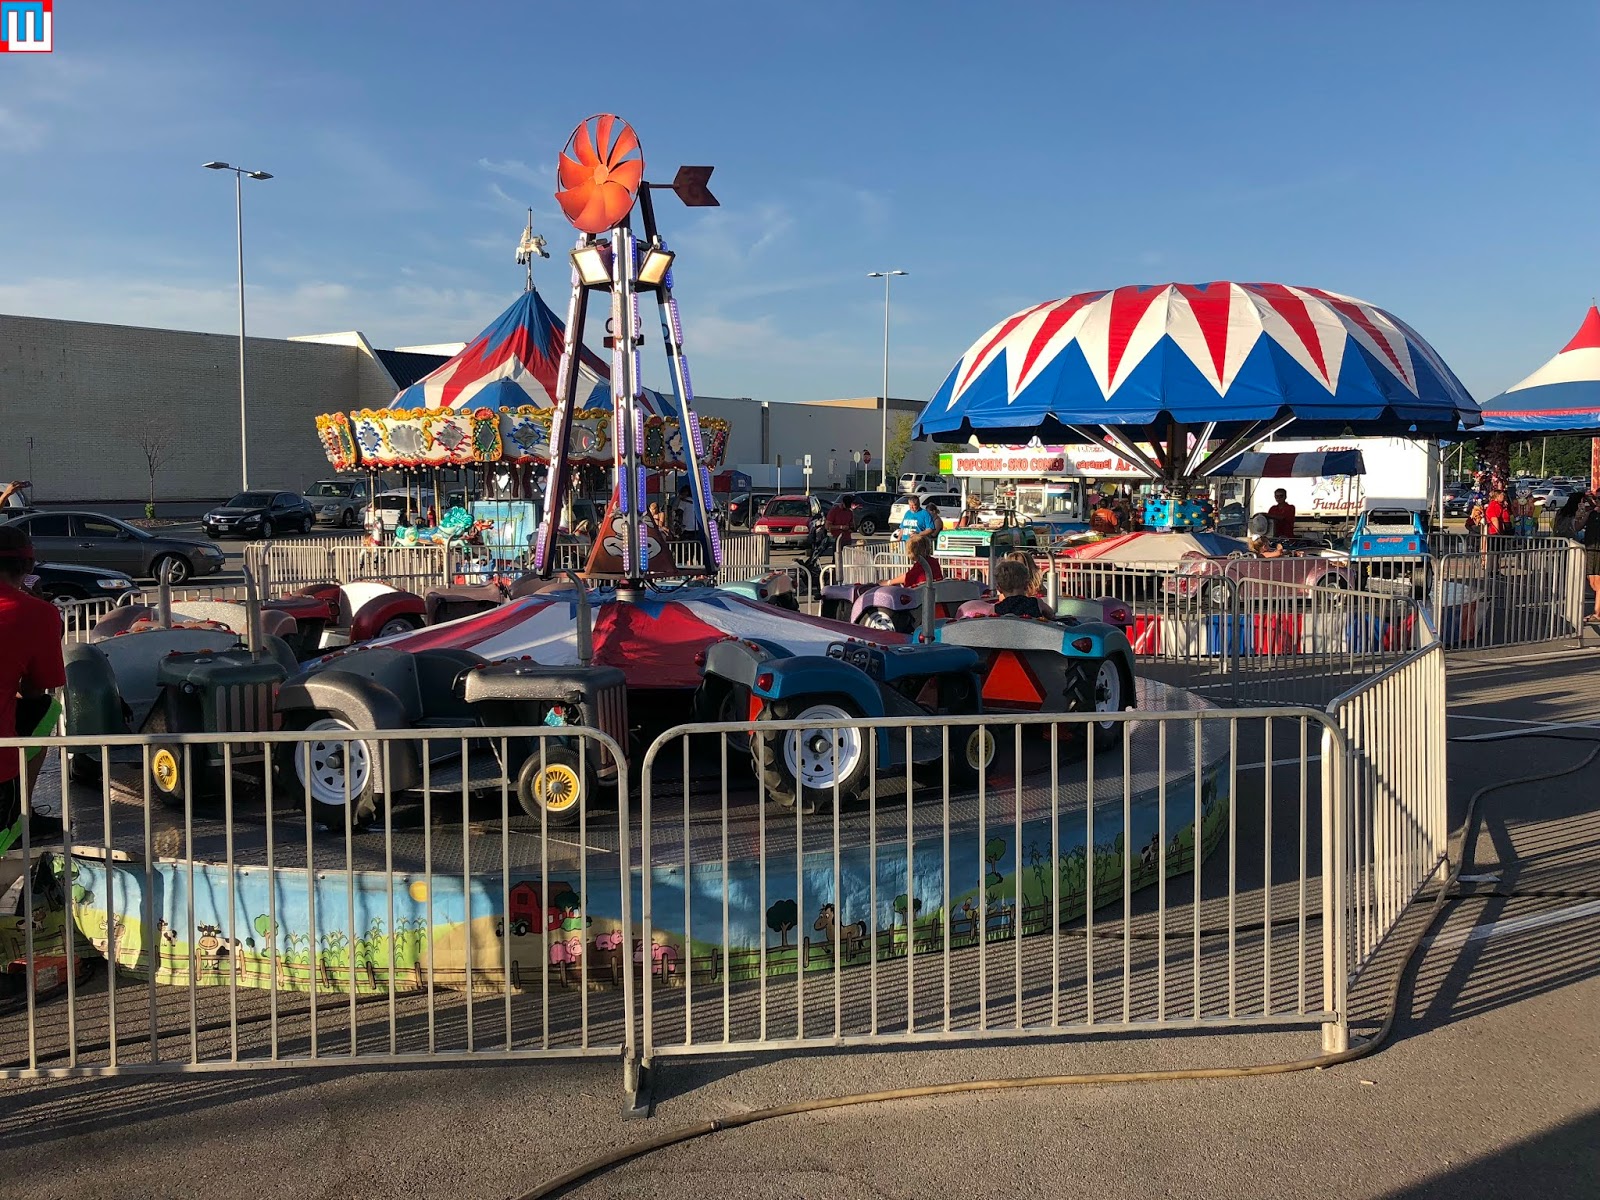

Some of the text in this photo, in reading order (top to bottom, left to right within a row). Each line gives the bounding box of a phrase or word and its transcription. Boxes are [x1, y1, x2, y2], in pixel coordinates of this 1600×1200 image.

[957, 458, 1002, 471] POPCORN
[1008, 458, 1028, 471] SNO
[1030, 458, 1064, 471] CONES
[1076, 458, 1112, 470] caramel
[1312, 496, 1366, 510] Funland
